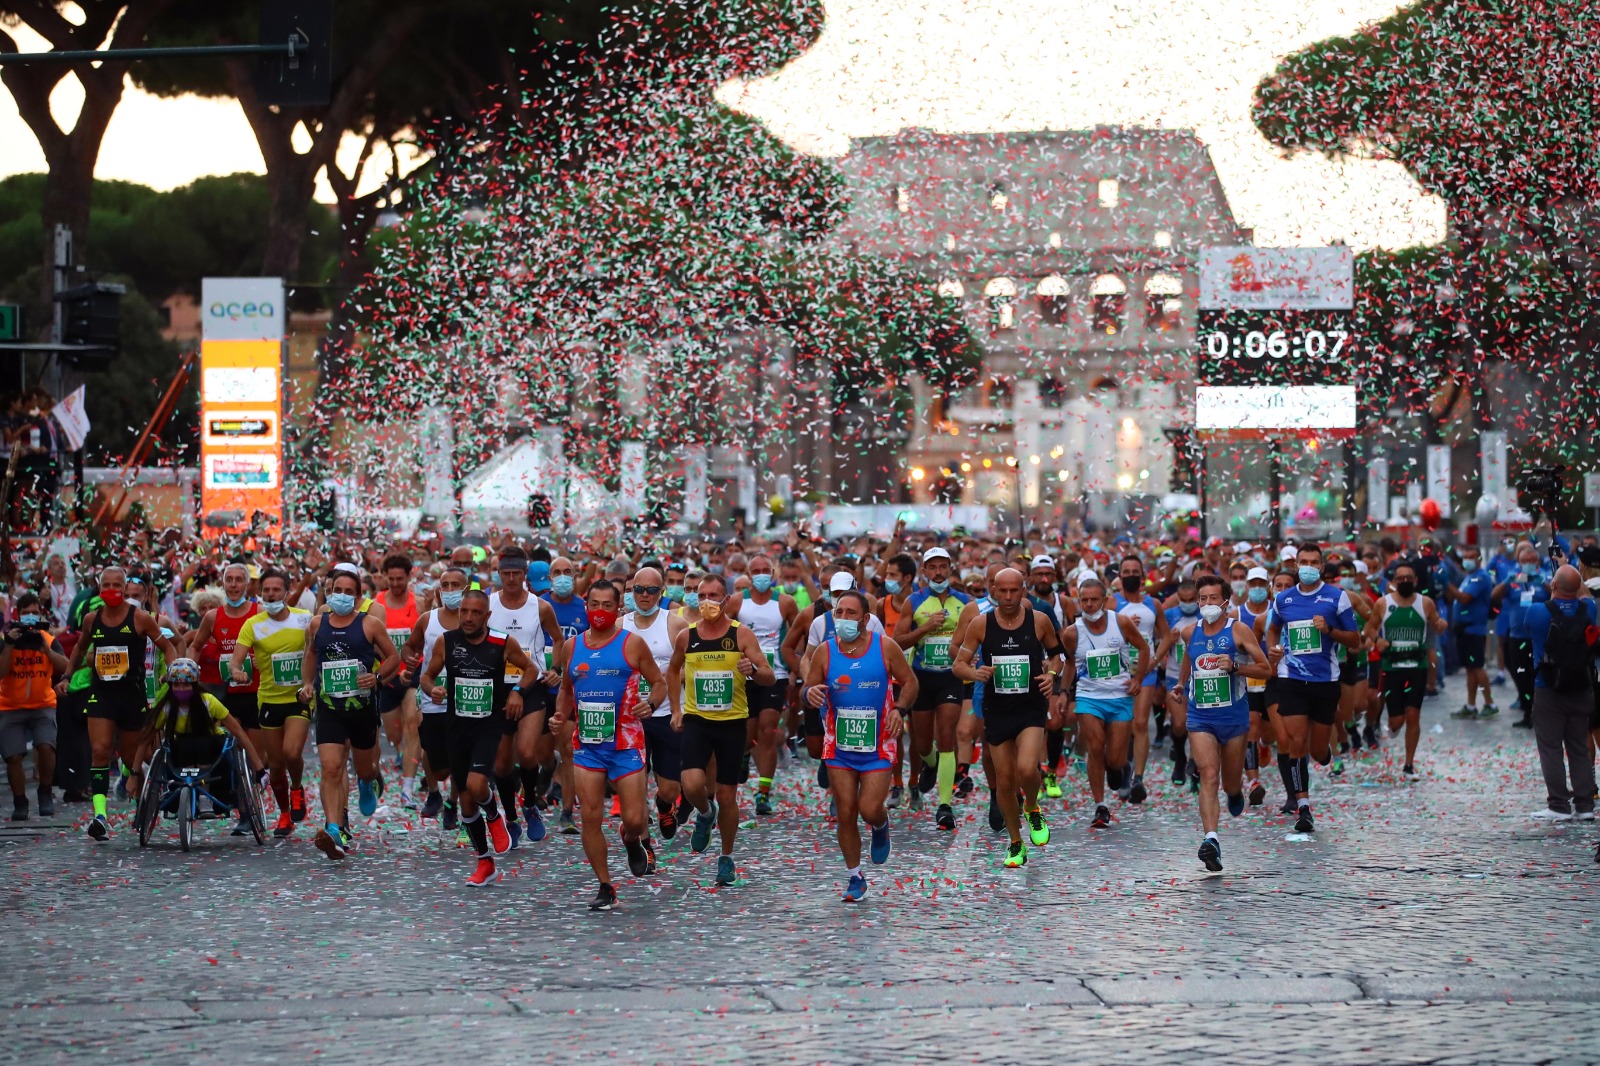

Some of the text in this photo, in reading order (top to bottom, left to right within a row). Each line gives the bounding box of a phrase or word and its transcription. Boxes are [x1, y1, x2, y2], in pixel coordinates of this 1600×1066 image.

[210, 302, 274, 318] acea
[1207, 330, 1349, 358] 0:06:07
[1296, 627, 1311, 639] 780
[934, 645, 949, 656] 664
[101, 653, 121, 665] 5818
[280, 660, 300, 671] 6072
[1096, 656, 1111, 668] 769
[330, 668, 351, 681] 4599
[1000, 664, 1022, 677] 1155
[703, 679, 725, 693] 4835
[1203, 679, 1218, 691] 581
[462, 686, 485, 700] 5289
[583, 712, 606, 726] 1036
[844, 719, 868, 734] 1362
